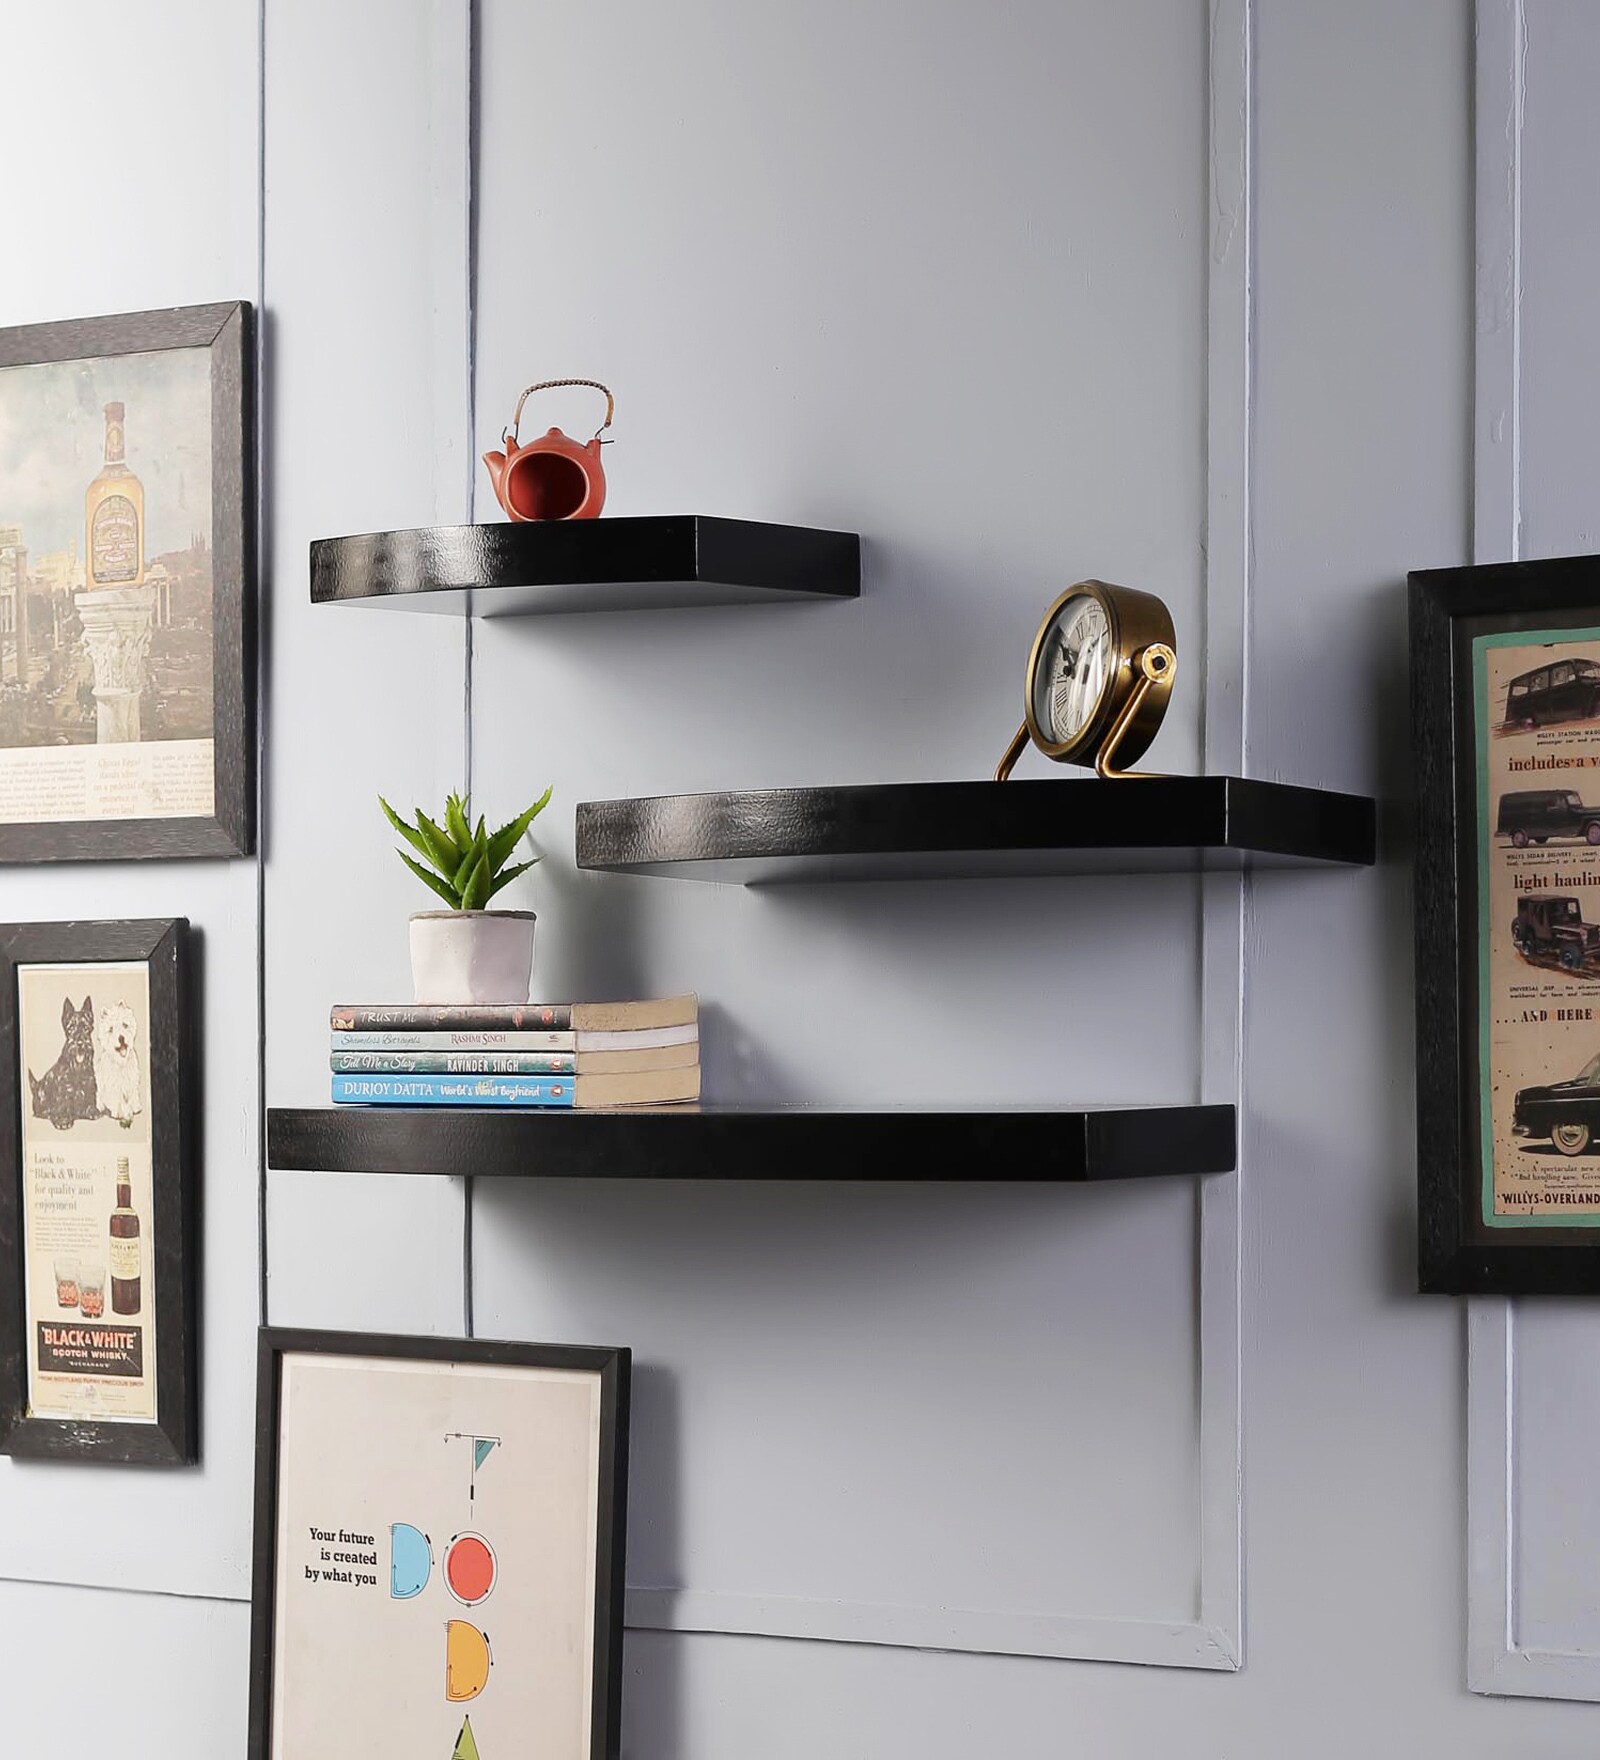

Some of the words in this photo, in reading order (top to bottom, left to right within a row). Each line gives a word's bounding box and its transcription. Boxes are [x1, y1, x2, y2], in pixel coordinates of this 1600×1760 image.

[1508, 754, 1571, 772] includes
[1576, 757, 1585, 768] a
[1514, 874, 1548, 894] light
[360, 1011, 401, 1023] TRUST
[401, 1012, 418, 1023] ME
[1557, 1008, 1593, 1021] HERE
[451, 1033, 481, 1044] RASHMI
[482, 1033, 506, 1045] SINGH
[340, 1055, 359, 1069] Tell
[362, 1055, 382, 1069] Me
[390, 1054, 416, 1072] Story
[447, 1059, 489, 1073] RAVINDER
[492, 1059, 519, 1073] SINGH
[343, 1082, 390, 1097] DURJOY
[394, 1082, 434, 1096] DATTA
[440, 1084, 473, 1096] World's
[34, 1152, 54, 1164] Look
[56, 1154, 65, 1164] to
[57, 1168, 65, 1180] &
[1540, 1164, 1578, 1174] spectacular
[34, 1183, 46, 1195] for
[48, 1183, 76, 1198] quality
[78, 1184, 94, 1195] and
[34, 1199, 78, 1213] enjoyment
[1502, 1193, 1600, 1205] WILLYS-OVERLAND
[52, 1348, 88, 1358] SCOTCH
[91, 1350, 127, 1361] WHISKY
[309, 1527, 336, 1542] Your
[338, 1529, 375, 1545] future
[320, 1547, 331, 1561] is
[333, 1552, 378, 1566] created
[304, 1565, 320, 1583] by
[322, 1568, 353, 1583] what
[354, 1573, 377, 1587] you
